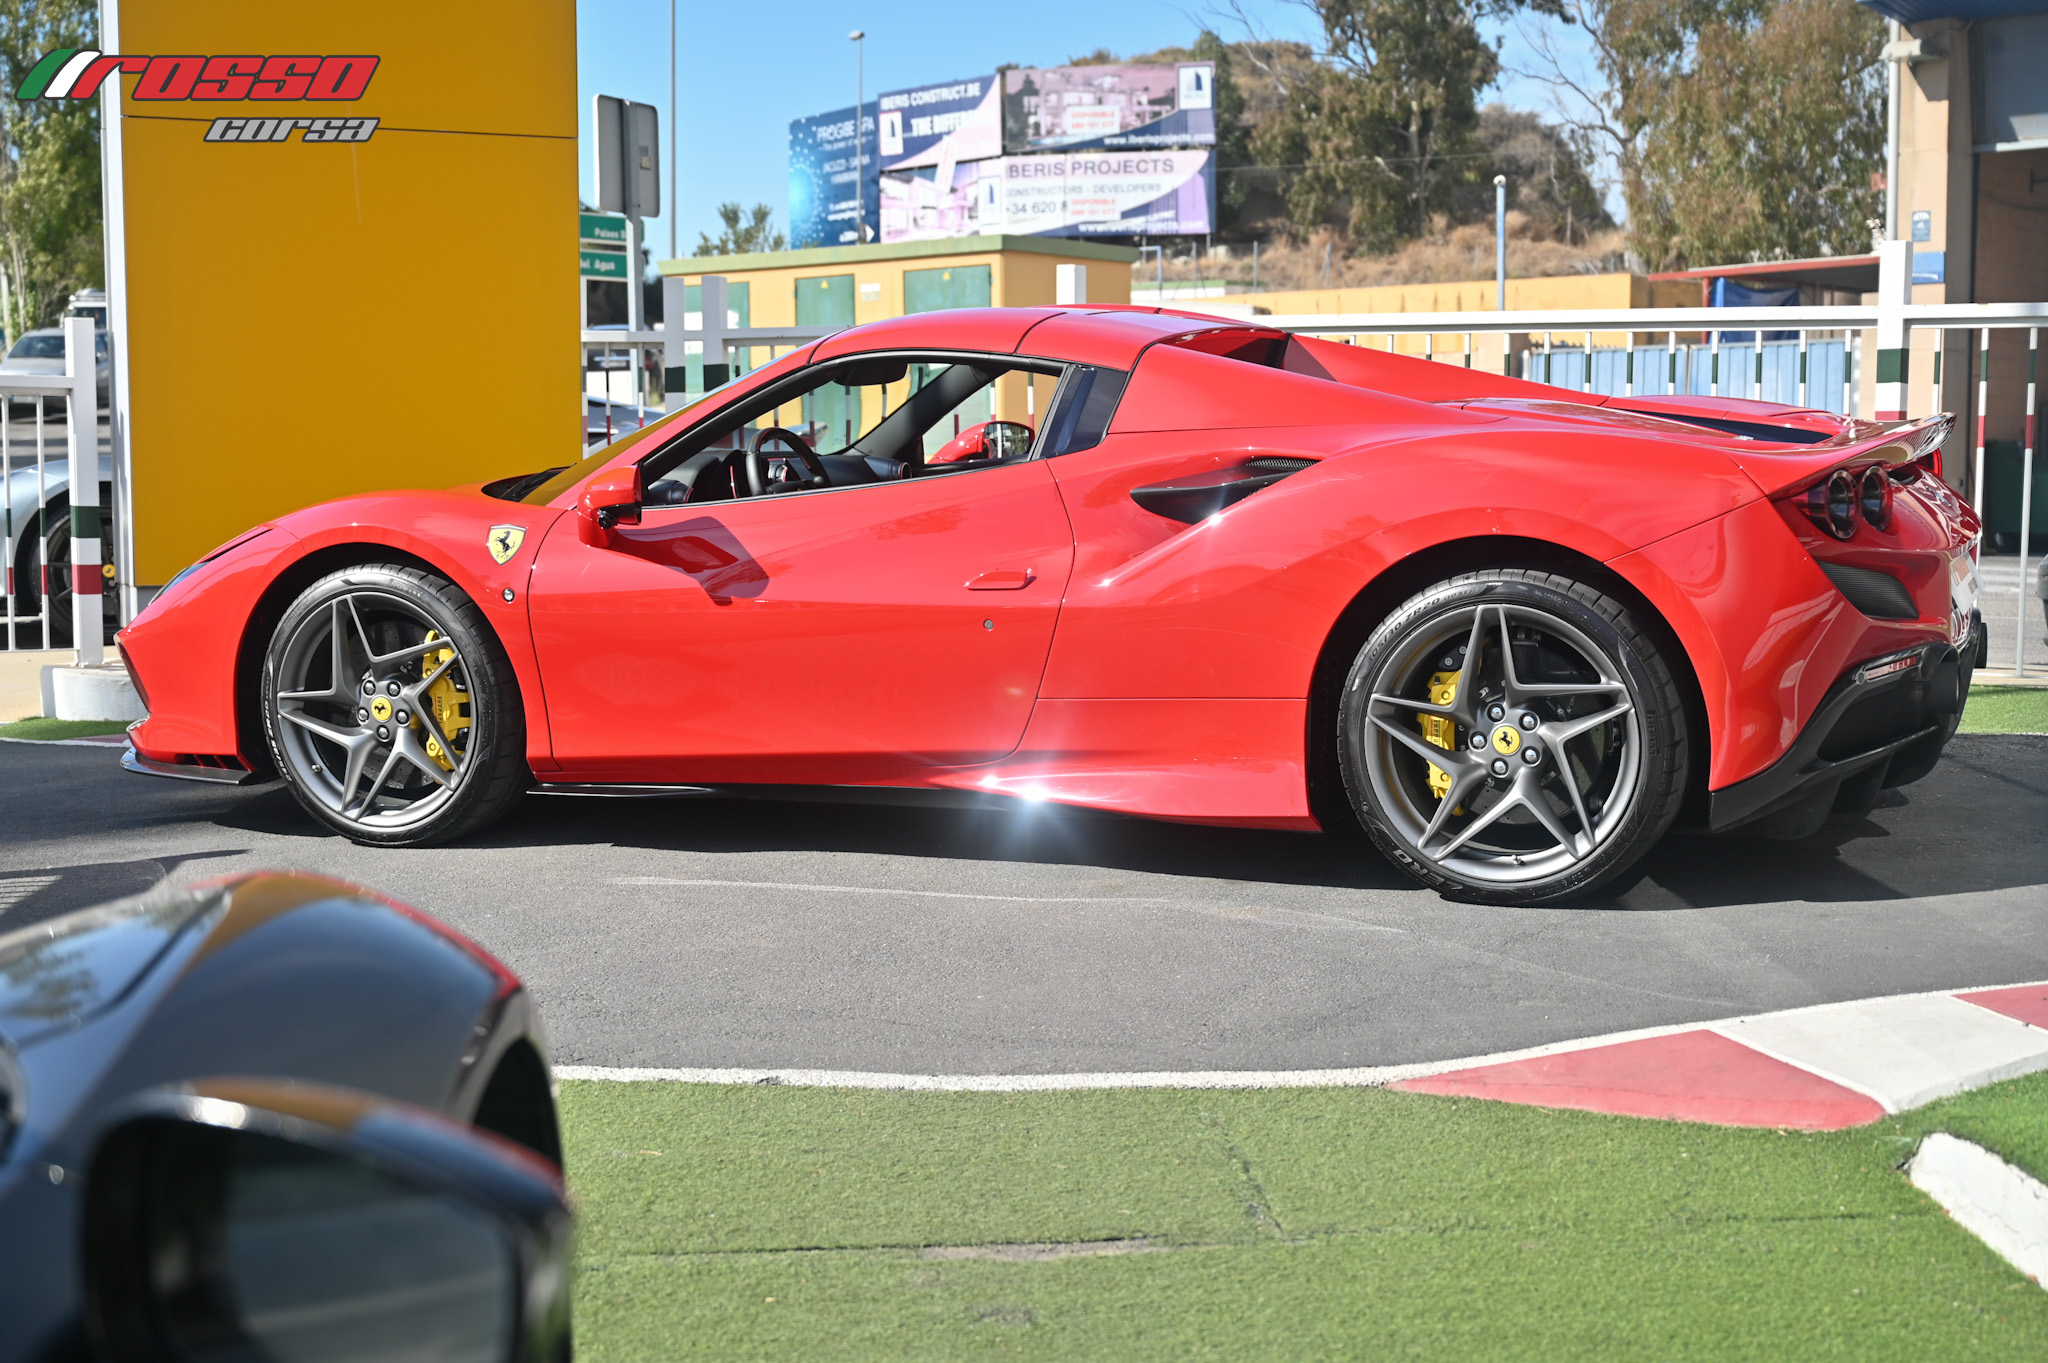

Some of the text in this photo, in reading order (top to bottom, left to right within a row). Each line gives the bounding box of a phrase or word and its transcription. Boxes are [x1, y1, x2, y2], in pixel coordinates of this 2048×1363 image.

[1071, 158, 1175, 176] PROJECTS
[1366, 621, 1402, 666] 305/30
[1404, 597, 1441, 623] ZR20
